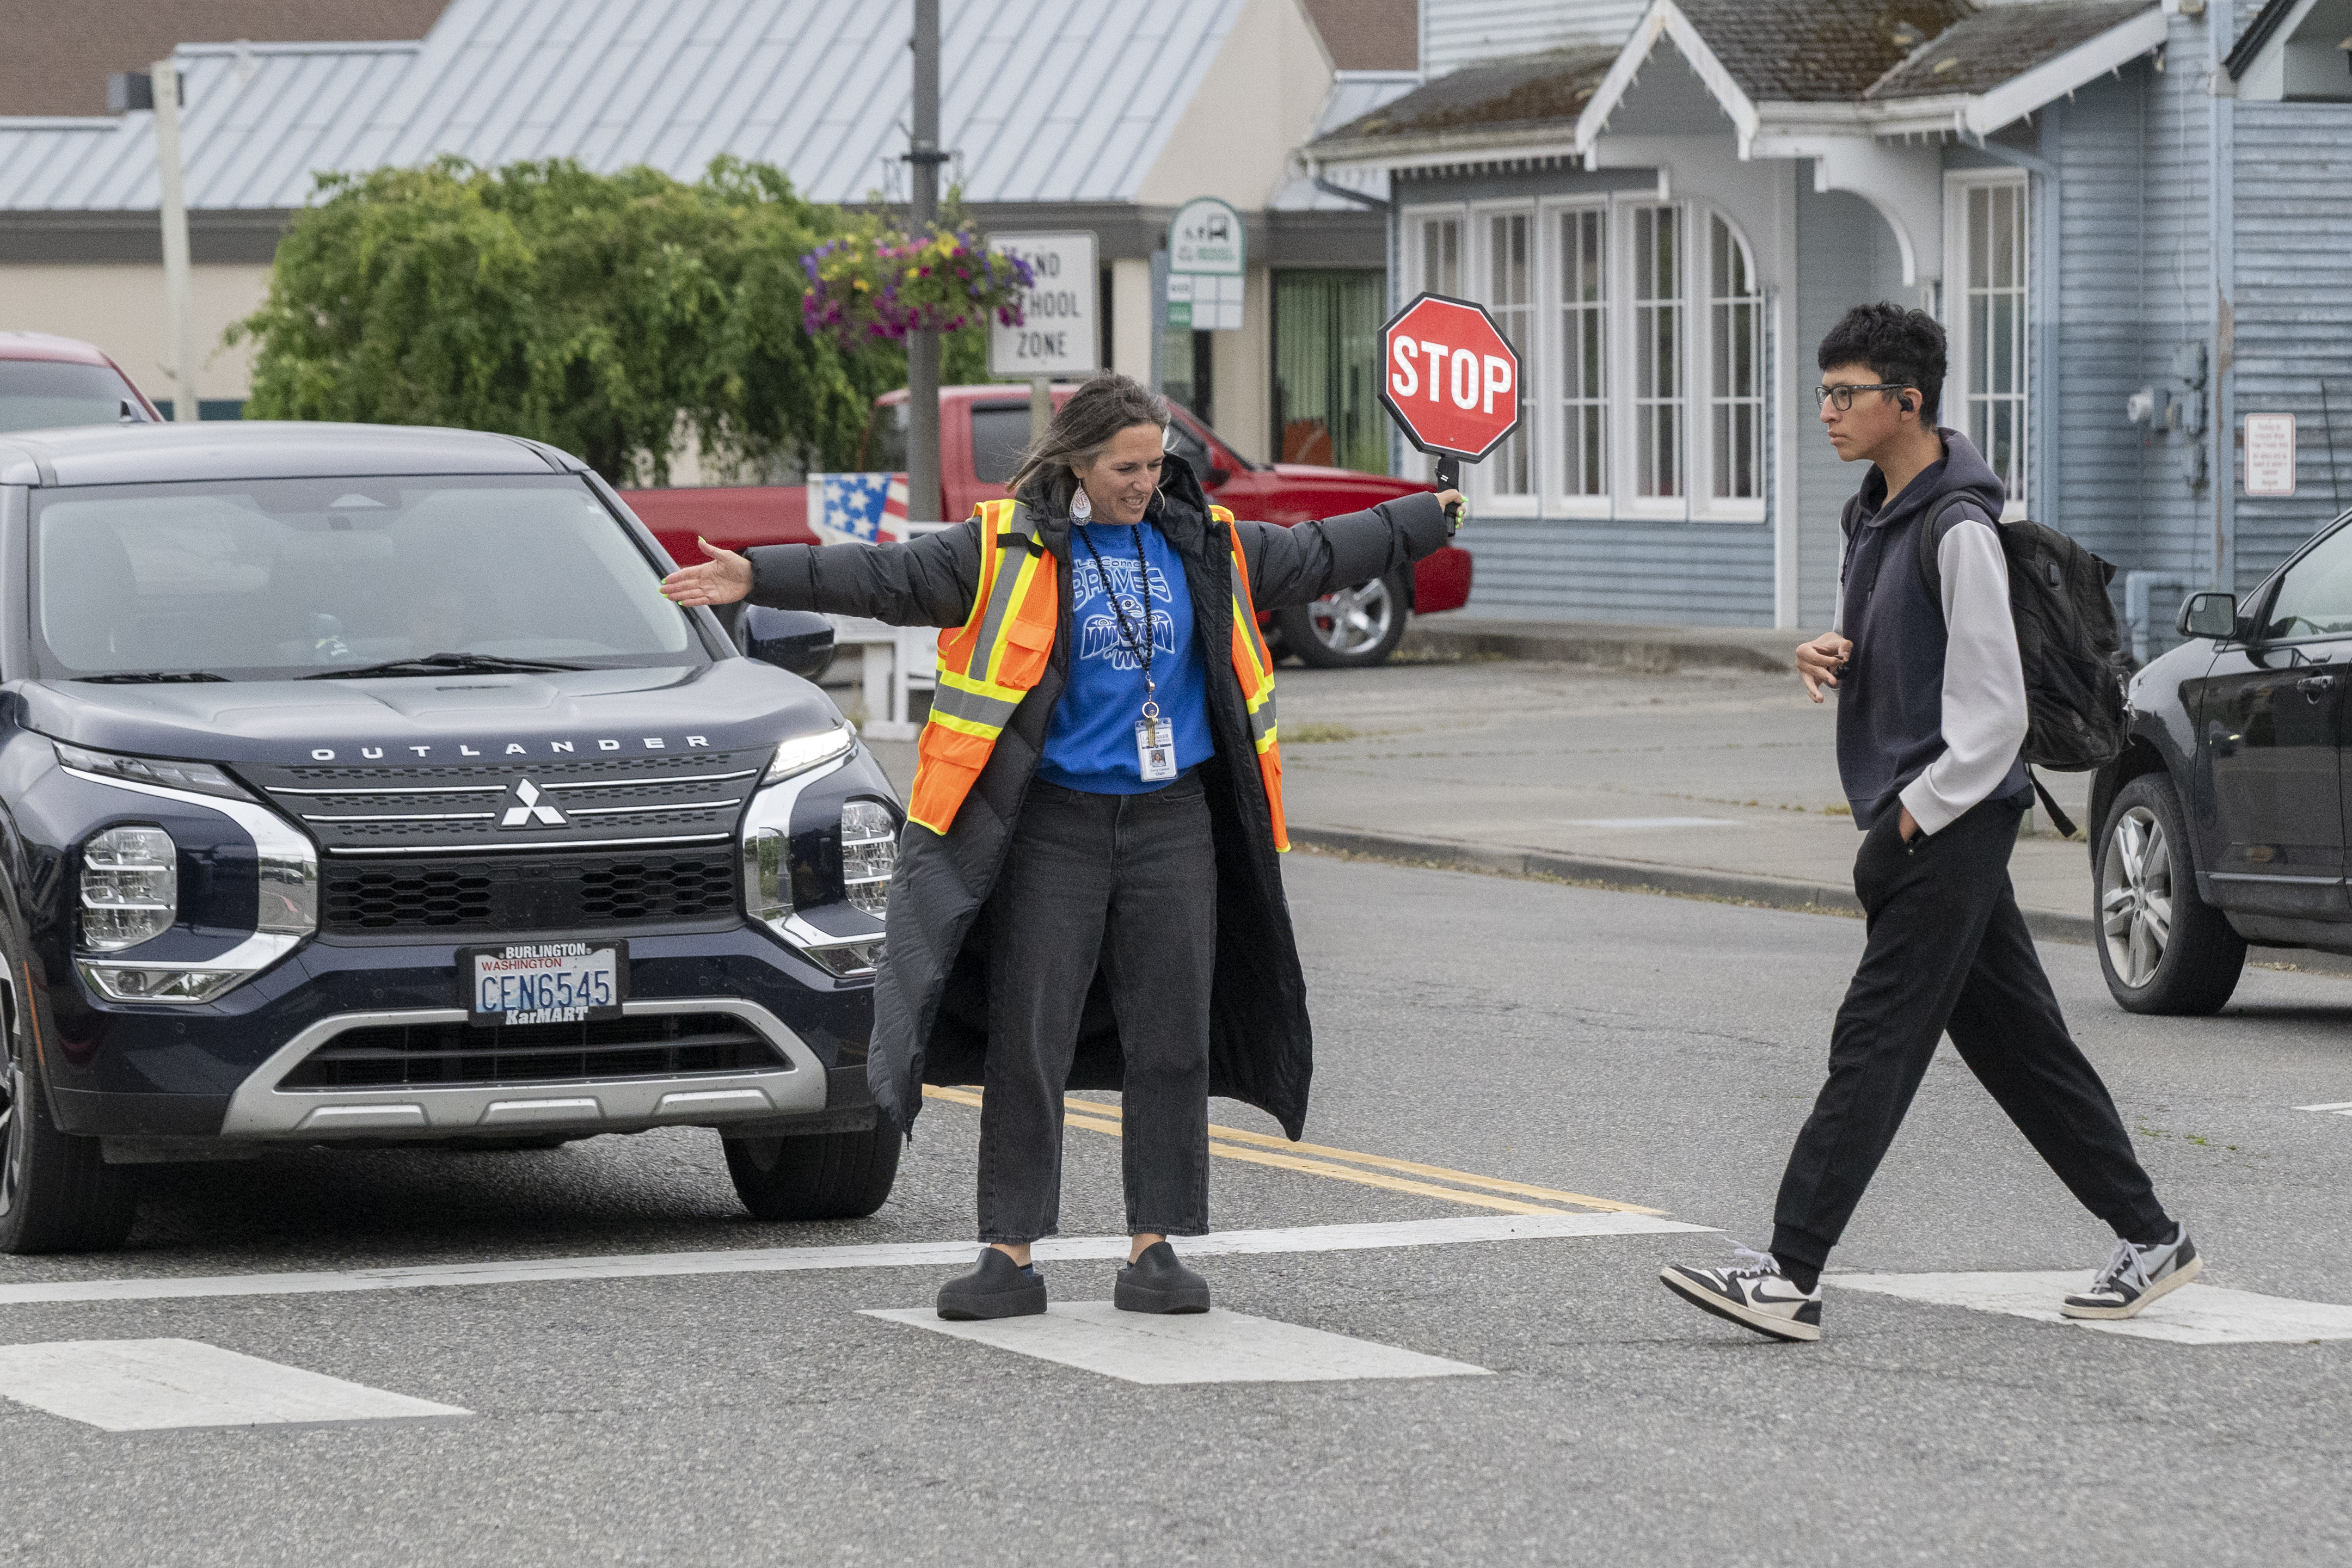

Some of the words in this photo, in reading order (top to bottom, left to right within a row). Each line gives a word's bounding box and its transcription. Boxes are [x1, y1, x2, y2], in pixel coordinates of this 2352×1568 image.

[1017, 330, 1067, 359] ZONE
[1392, 335, 1512, 414] STOP
[1075, 559, 1096, 568] La
[1100, 556, 1150, 568] Conne
[311, 735, 709, 761] OUTLANDER
[506, 943, 586, 960] BURLINGTON
[481, 957, 562, 971] WASHINGTON
[482, 970, 610, 1011] CEN6545
[505, 1005, 589, 1025] KarMART
